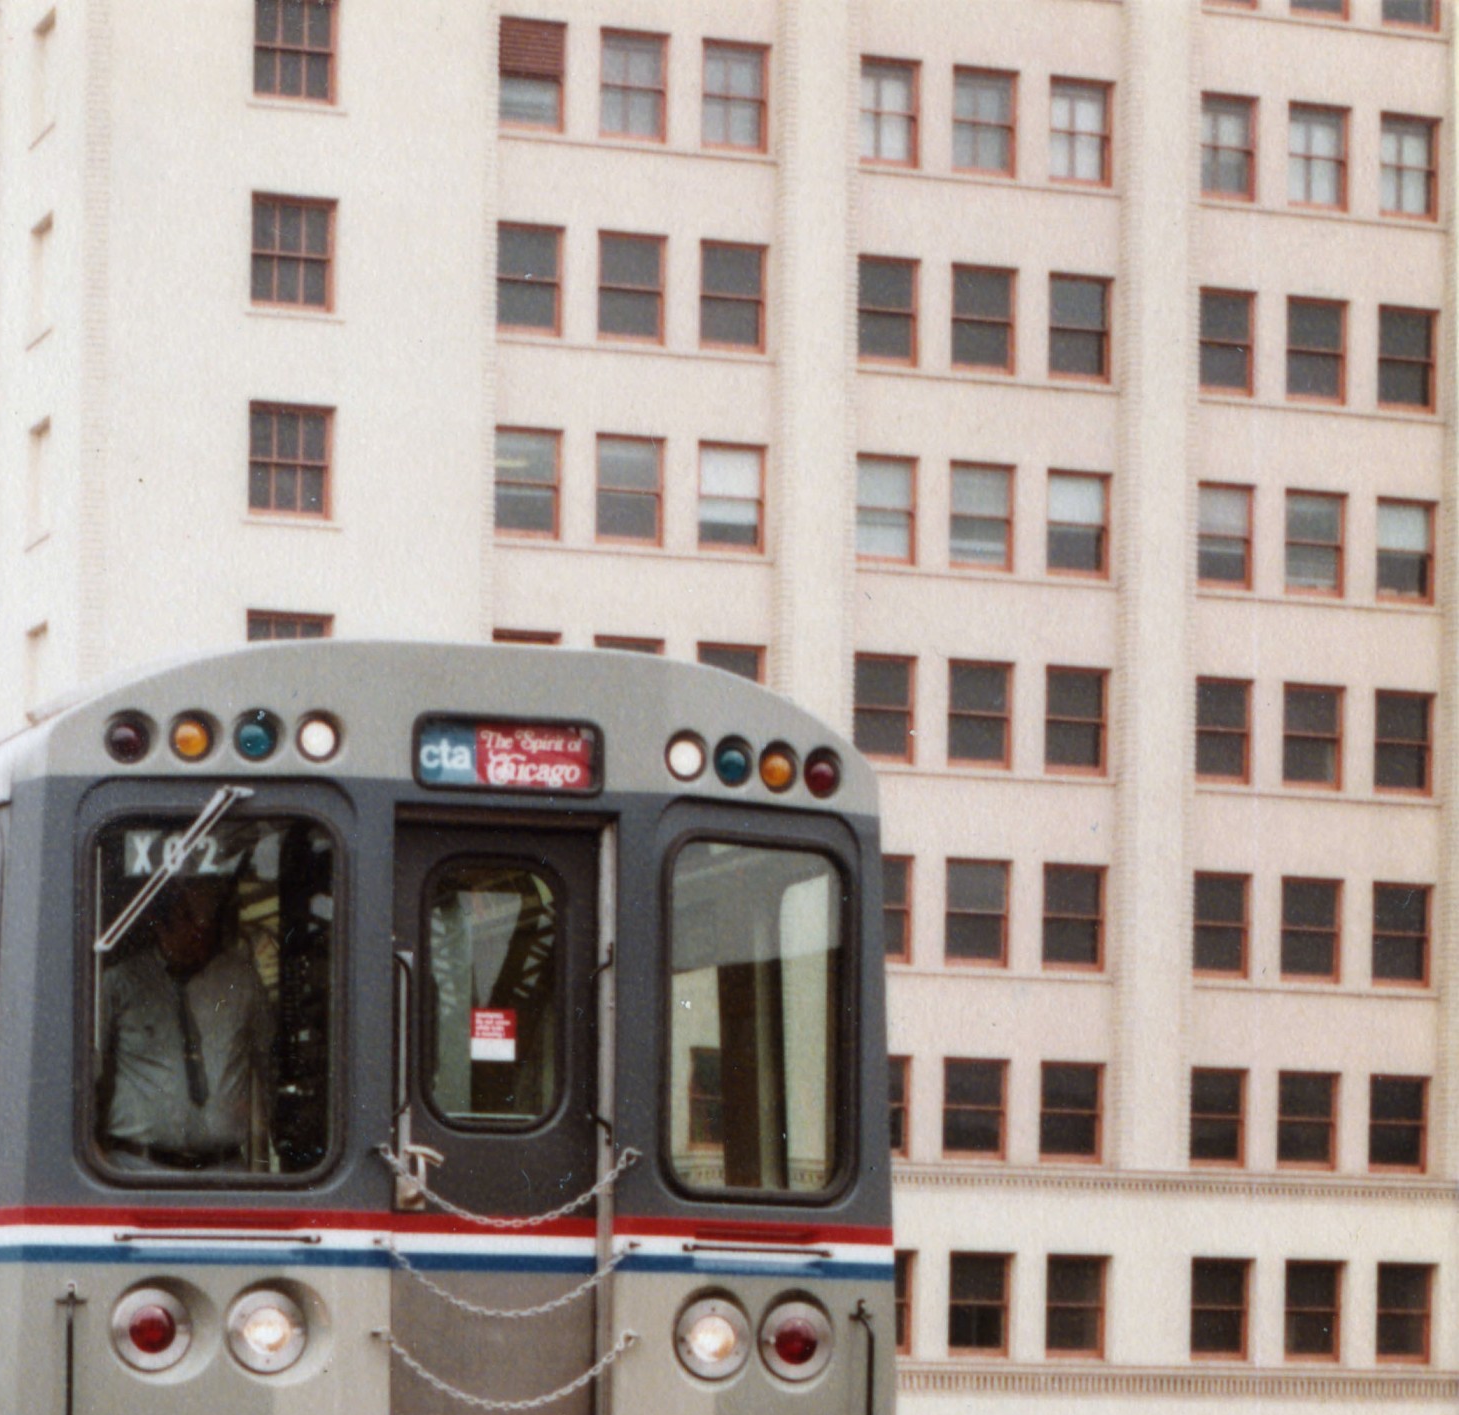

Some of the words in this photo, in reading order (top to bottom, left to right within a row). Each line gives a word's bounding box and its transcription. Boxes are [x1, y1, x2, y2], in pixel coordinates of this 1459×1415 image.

[420, 739, 472, 770] cta
[481, 731, 513, 749] The
[515, 731, 563, 754] Spirit
[567, 738, 582, 752] of
[486, 751, 581, 788] Chicago
